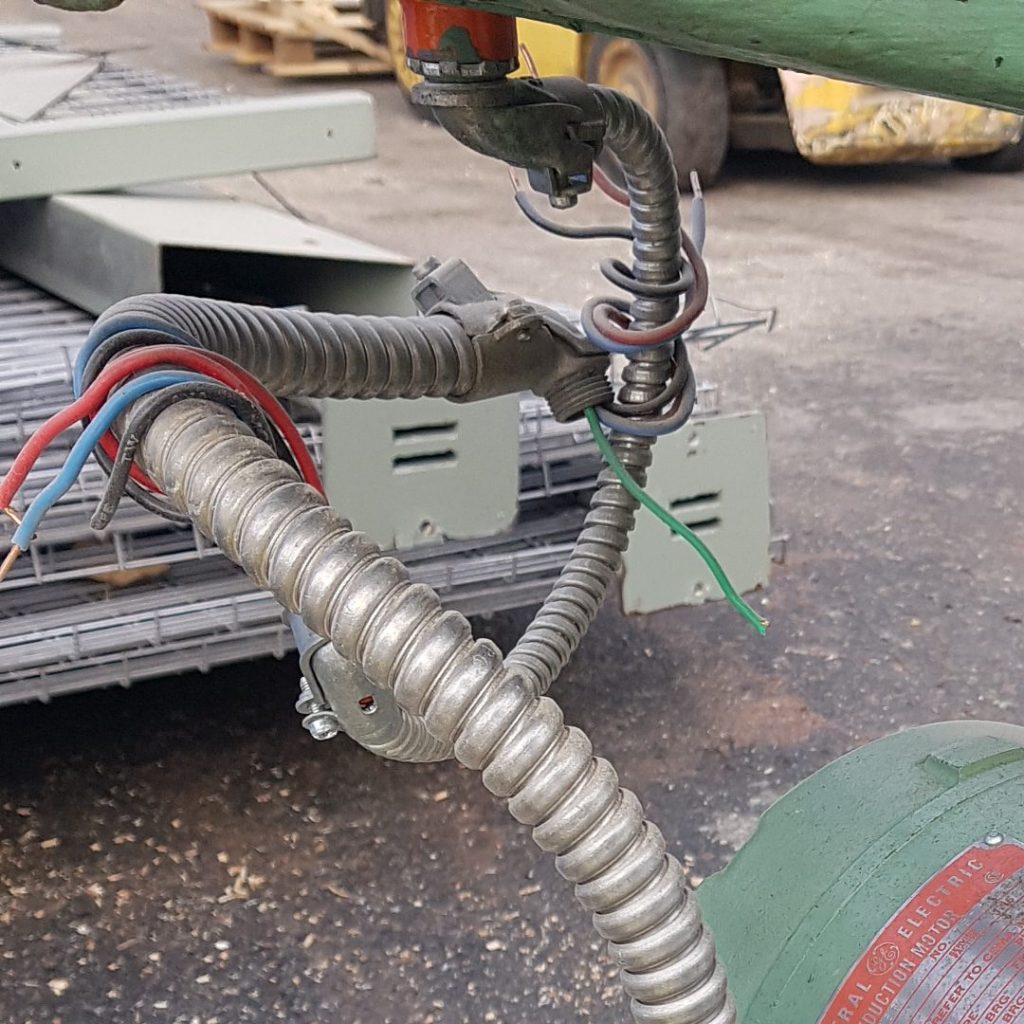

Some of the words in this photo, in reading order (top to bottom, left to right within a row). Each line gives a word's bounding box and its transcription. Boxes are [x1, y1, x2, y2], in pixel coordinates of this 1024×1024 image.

[896, 857, 984, 939] ELECTRIC
[910, 908, 959, 958] MOTOR
[928, 941, 951, 960] NO.
[963, 965, 982, 981] TO
[984, 994, 1011, 1022] BRG
